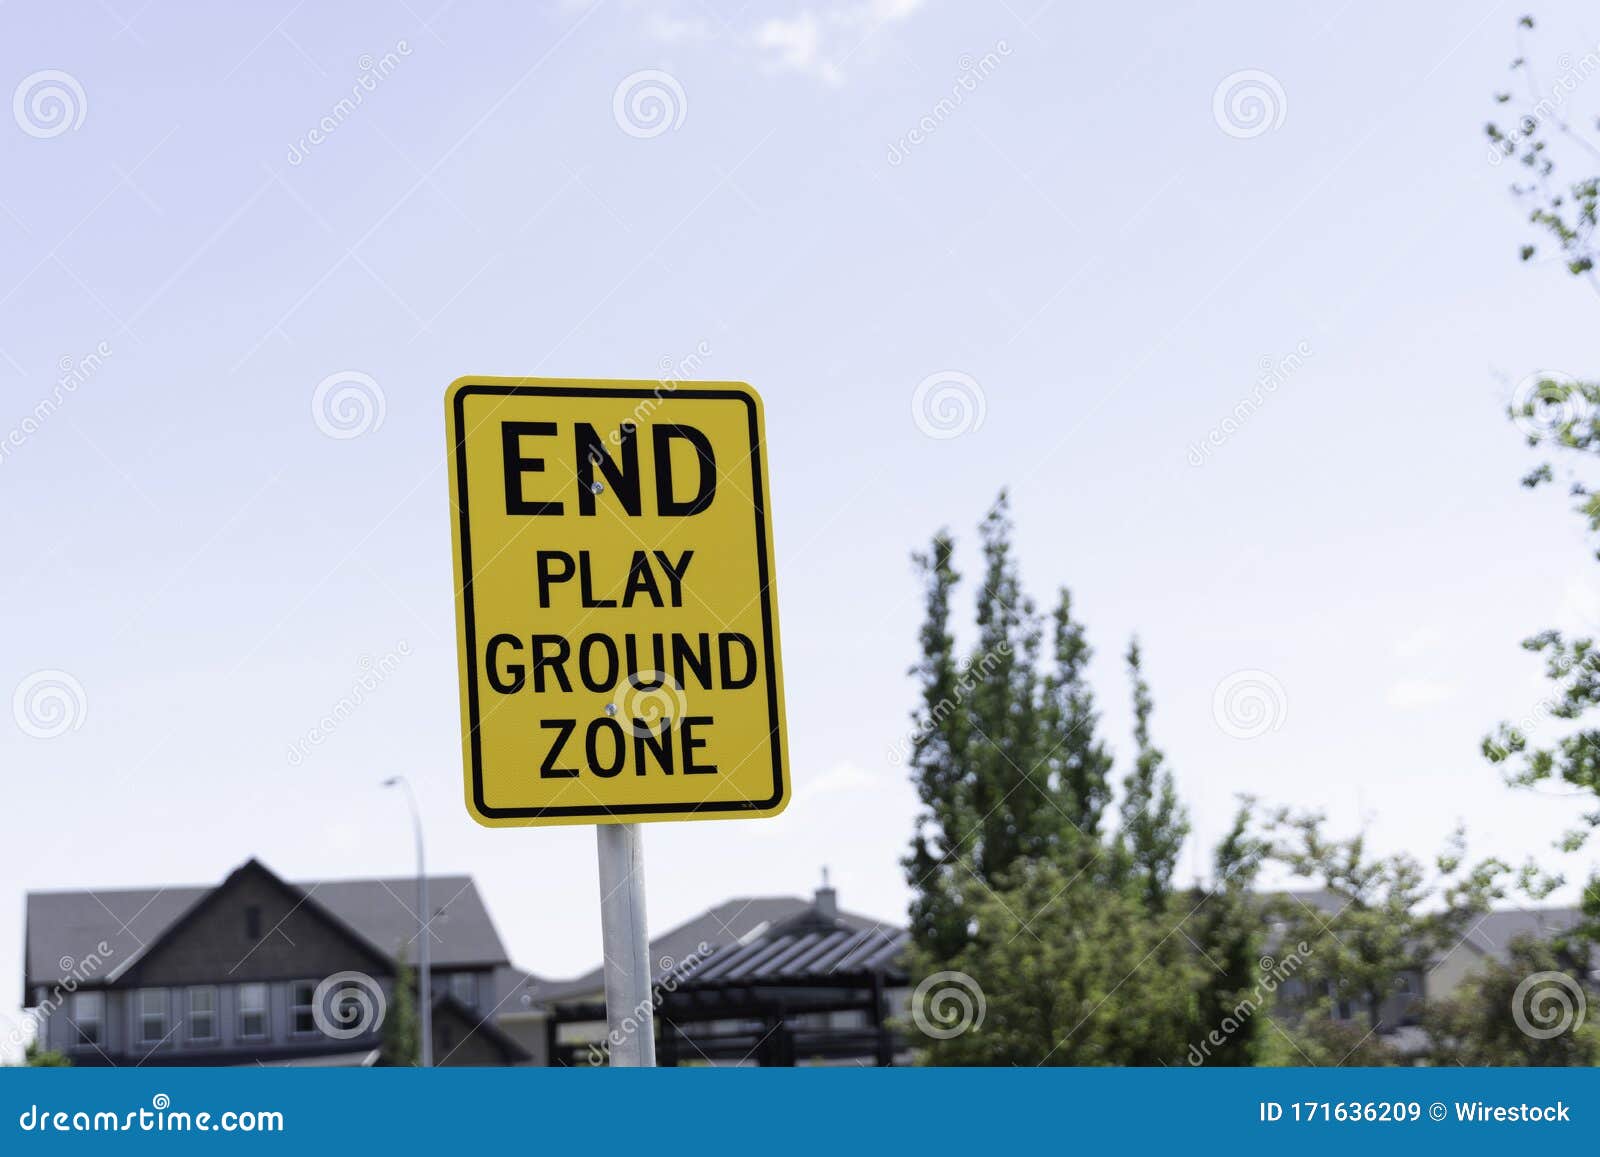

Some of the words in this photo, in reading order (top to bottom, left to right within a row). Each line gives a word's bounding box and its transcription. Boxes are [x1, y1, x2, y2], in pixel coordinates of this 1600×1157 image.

[501, 421, 717, 516] END
[536, 550, 694, 608] PLAY
[485, 633, 757, 694] GROUND
[539, 716, 718, 778] ZONE
